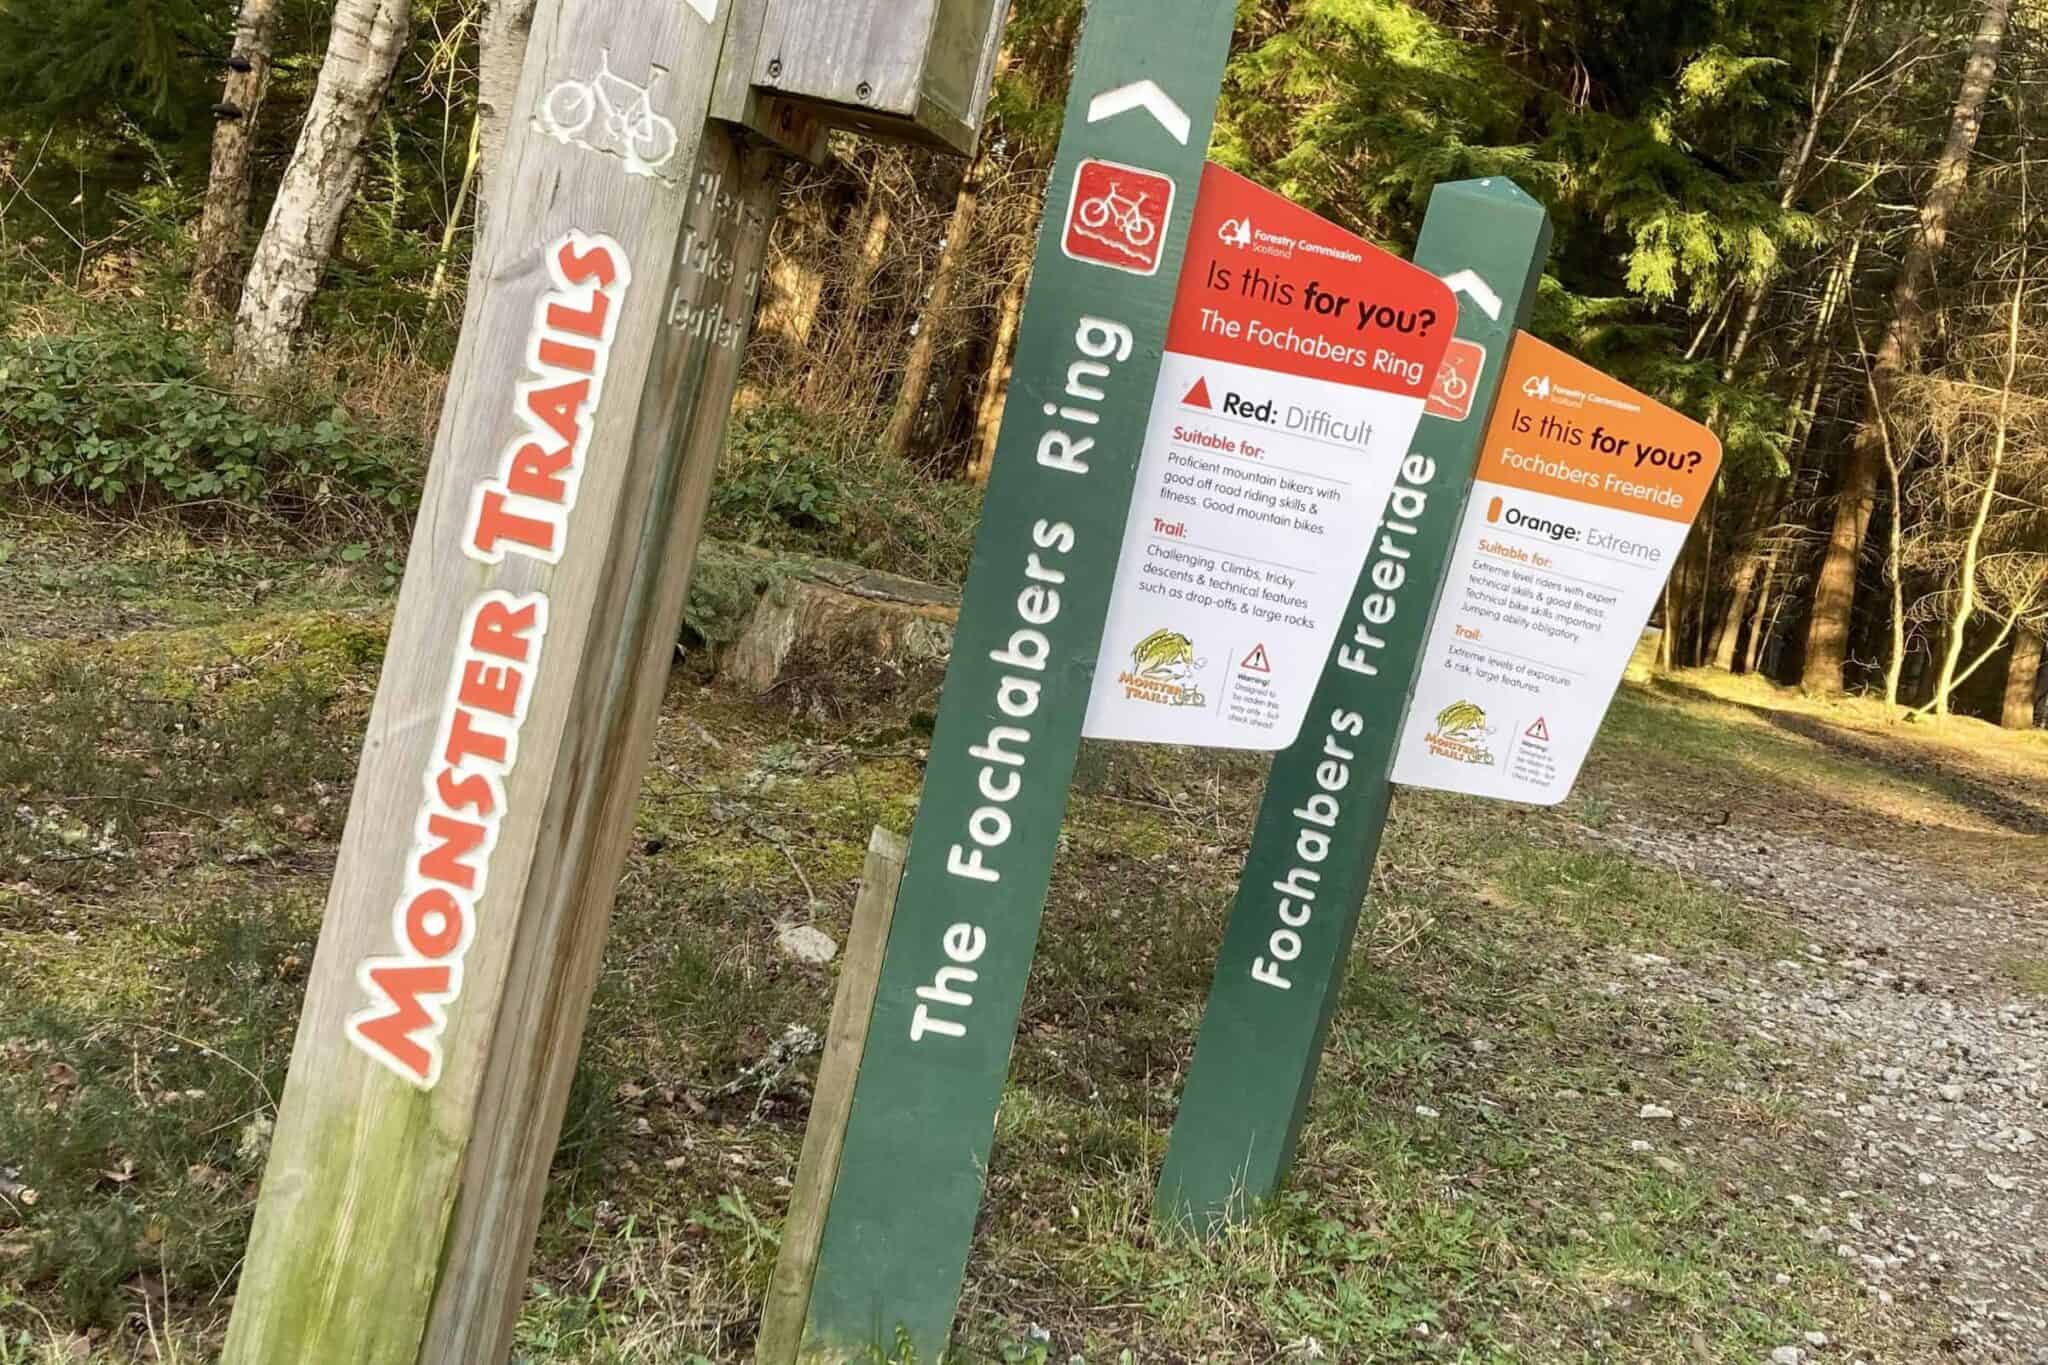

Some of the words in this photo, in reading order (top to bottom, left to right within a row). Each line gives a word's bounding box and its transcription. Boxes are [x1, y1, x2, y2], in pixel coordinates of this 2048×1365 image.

[1254, 229, 1296, 249] Forestry
[1298, 238, 1362, 263] Commission
[1207, 260, 1230, 291] Is
[1242, 268, 1295, 306] this
[1304, 282, 1349, 317] for
[1357, 301, 1436, 337] you?
[1200, 308, 1241, 338] The
[1246, 320, 1366, 368] Fochabers
[1372, 350, 1424, 385] Ring
[1036, 315, 1133, 474] Ring
[1223, 392, 1278, 424] Red:
[1285, 406, 1373, 446] Difficult
[1511, 408, 1530, 432] Is
[1539, 415, 1582, 446] this
[1590, 427, 1629, 454] for
[1634, 443, 1701, 475] you?
[1173, 427, 1235, 456] Suitable
[1240, 438, 1264, 459] for:
[1163, 471, 1194, 489] good
[1196, 476, 1213, 491] off
[1214, 481, 1241, 499] road
[1244, 488, 1276, 510] riding
[1279, 496, 1305, 513] skills
[1309, 503, 1318, 515] &
[1168, 452, 1220, 474] Proficient
[1223, 466, 1277, 488] mountain
[1279, 477, 1314, 496] bikers
[1317, 485, 1341, 502] with
[1500, 447, 1599, 489] Fochabers
[1604, 473, 1683, 509] Freeride
[1153, 518, 1188, 538] Trail:
[1202, 497, 1234, 516] Good
[1237, 506, 1291, 528] mountain
[1505, 507, 1581, 542] Orange:
[1586, 527, 1661, 562] Extreme
[1477, 539, 1529, 563] Suitable
[1531, 551, 1552, 568] for:
[1139, 580, 1166, 598] such
[1169, 587, 1183, 600] as
[1186, 589, 1238, 612] drop-offs
[1240, 603, 1249, 615] &
[1253, 604, 1281, 624] large
[1143, 562, 1194, 584] descents
[1196, 574, 1205, 585] &
[1209, 577, 1259, 599] technical
[1262, 590, 1308, 610] features
[1265, 569, 1296, 590] tricky
[1472, 559, 1510, 578] Extreme
[1512, 568, 1533, 584] level
[1535, 574, 1561, 592] riders
[1564, 582, 1584, 598] with
[1586, 589, 1616, 606] expert
[1512, 586, 1534, 600] skills
[1536, 591, 1544, 601] &
[1546, 594, 1572, 610] good
[1460, 602, 1500, 622] Jumping
[1502, 612, 1530, 630] ability
[1508, 598, 1528, 612] bike
[1530, 602, 1552, 617] skills
[357, 597, 538, 1079] MONSTER
[473, 241, 616, 552] TRAILS
[1448, 645, 1486, 663] Extreme
[1488, 655, 1513, 670] levels
[1515, 662, 1526, 674] of
[947, 519, 1075, 882] Fochabers
[1118, 671, 1182, 696] MONSTER
[1125, 687, 1169, 705] TRAILS
[1252, 708, 1363, 989] Fochabers
[1338, 454, 1436, 676] Freeride
[910, 922, 986, 1042] The
